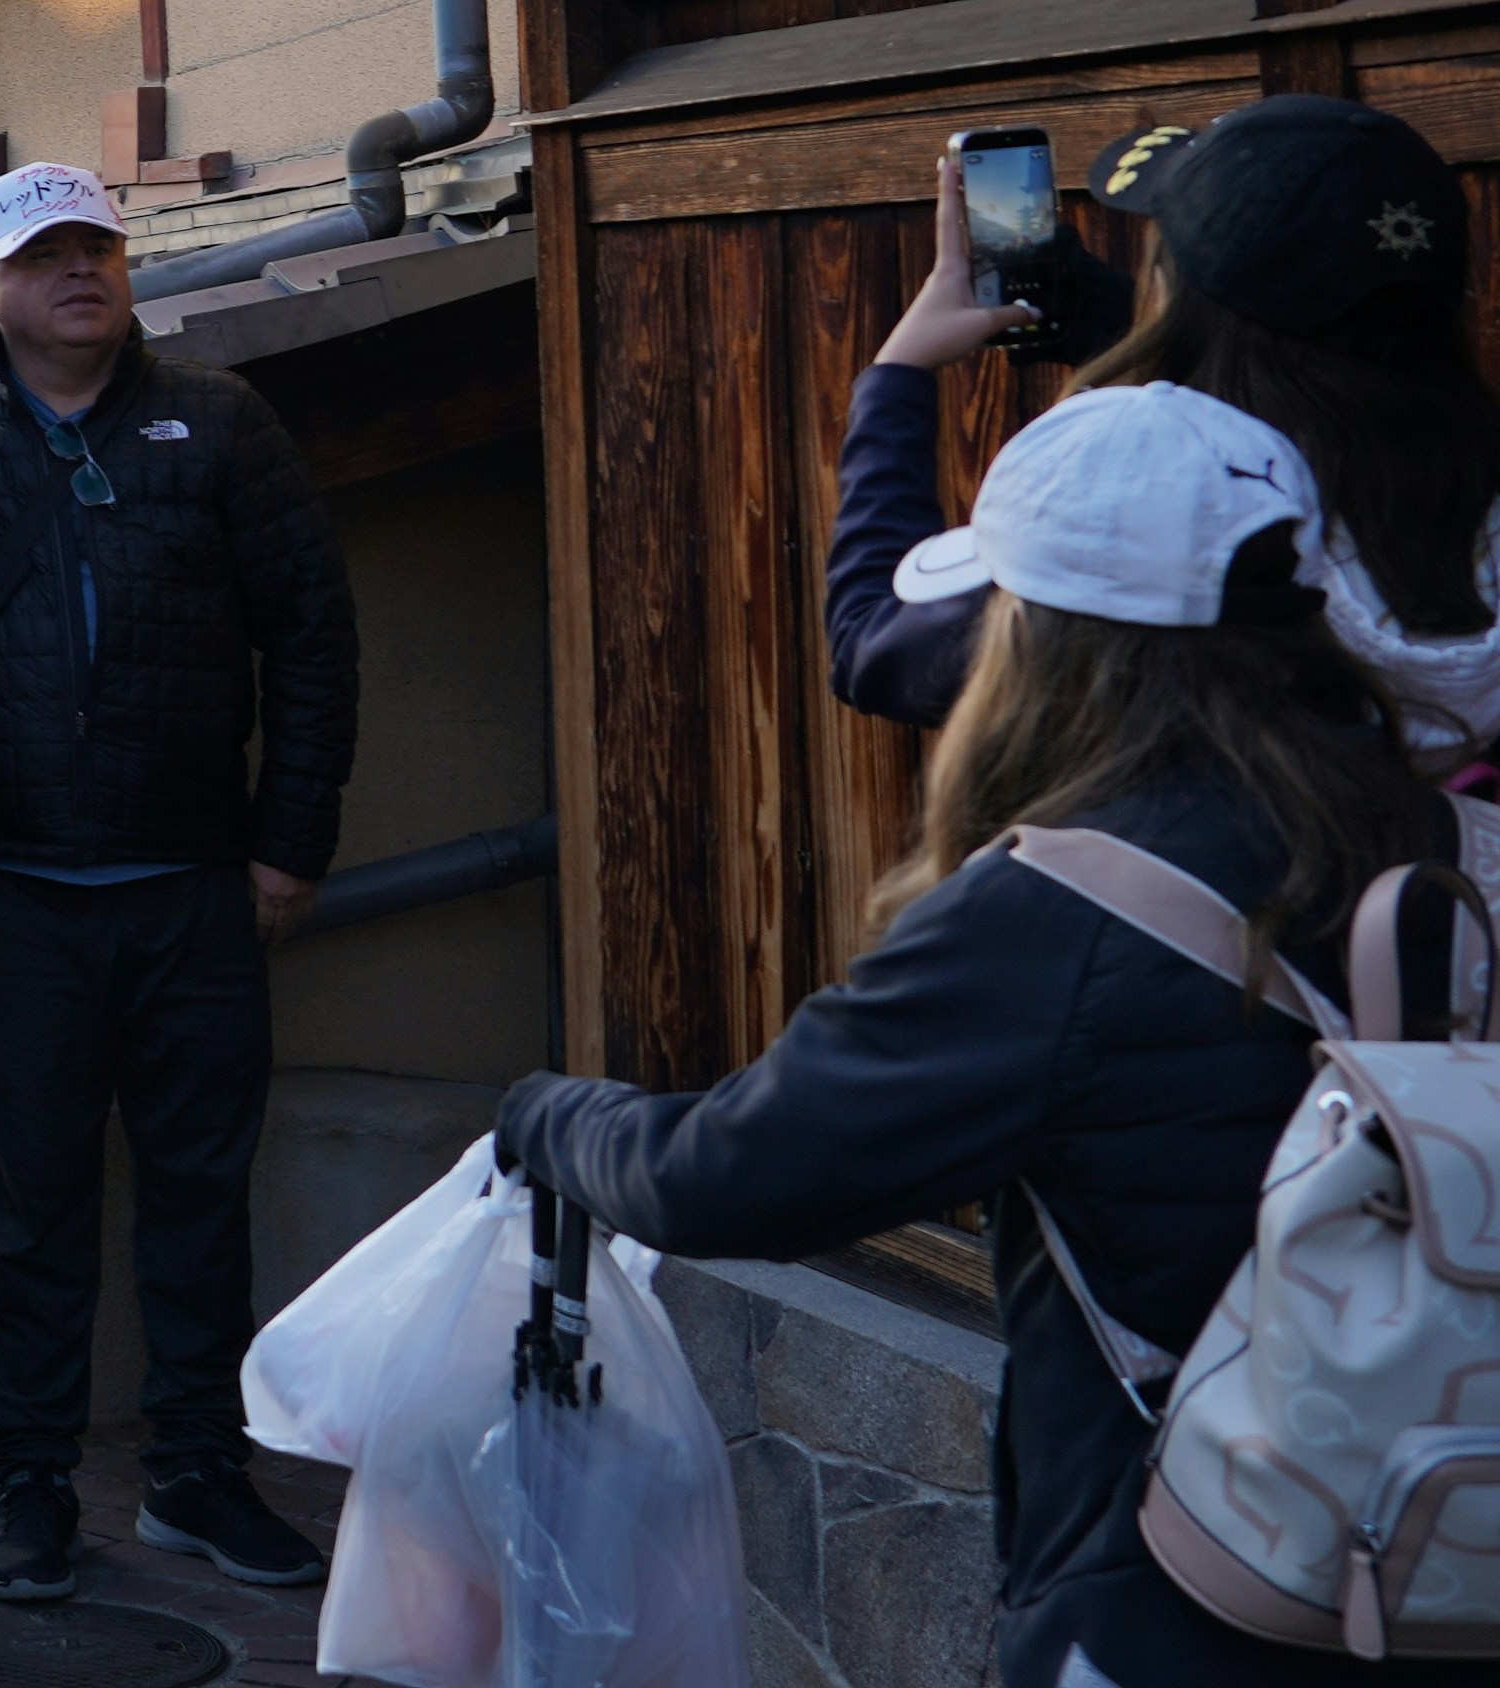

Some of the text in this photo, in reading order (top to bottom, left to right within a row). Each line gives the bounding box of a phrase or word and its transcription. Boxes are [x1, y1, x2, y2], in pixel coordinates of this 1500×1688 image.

[16, 166, 70, 184] オラクル
[21, 197, 80, 219] レーシング
